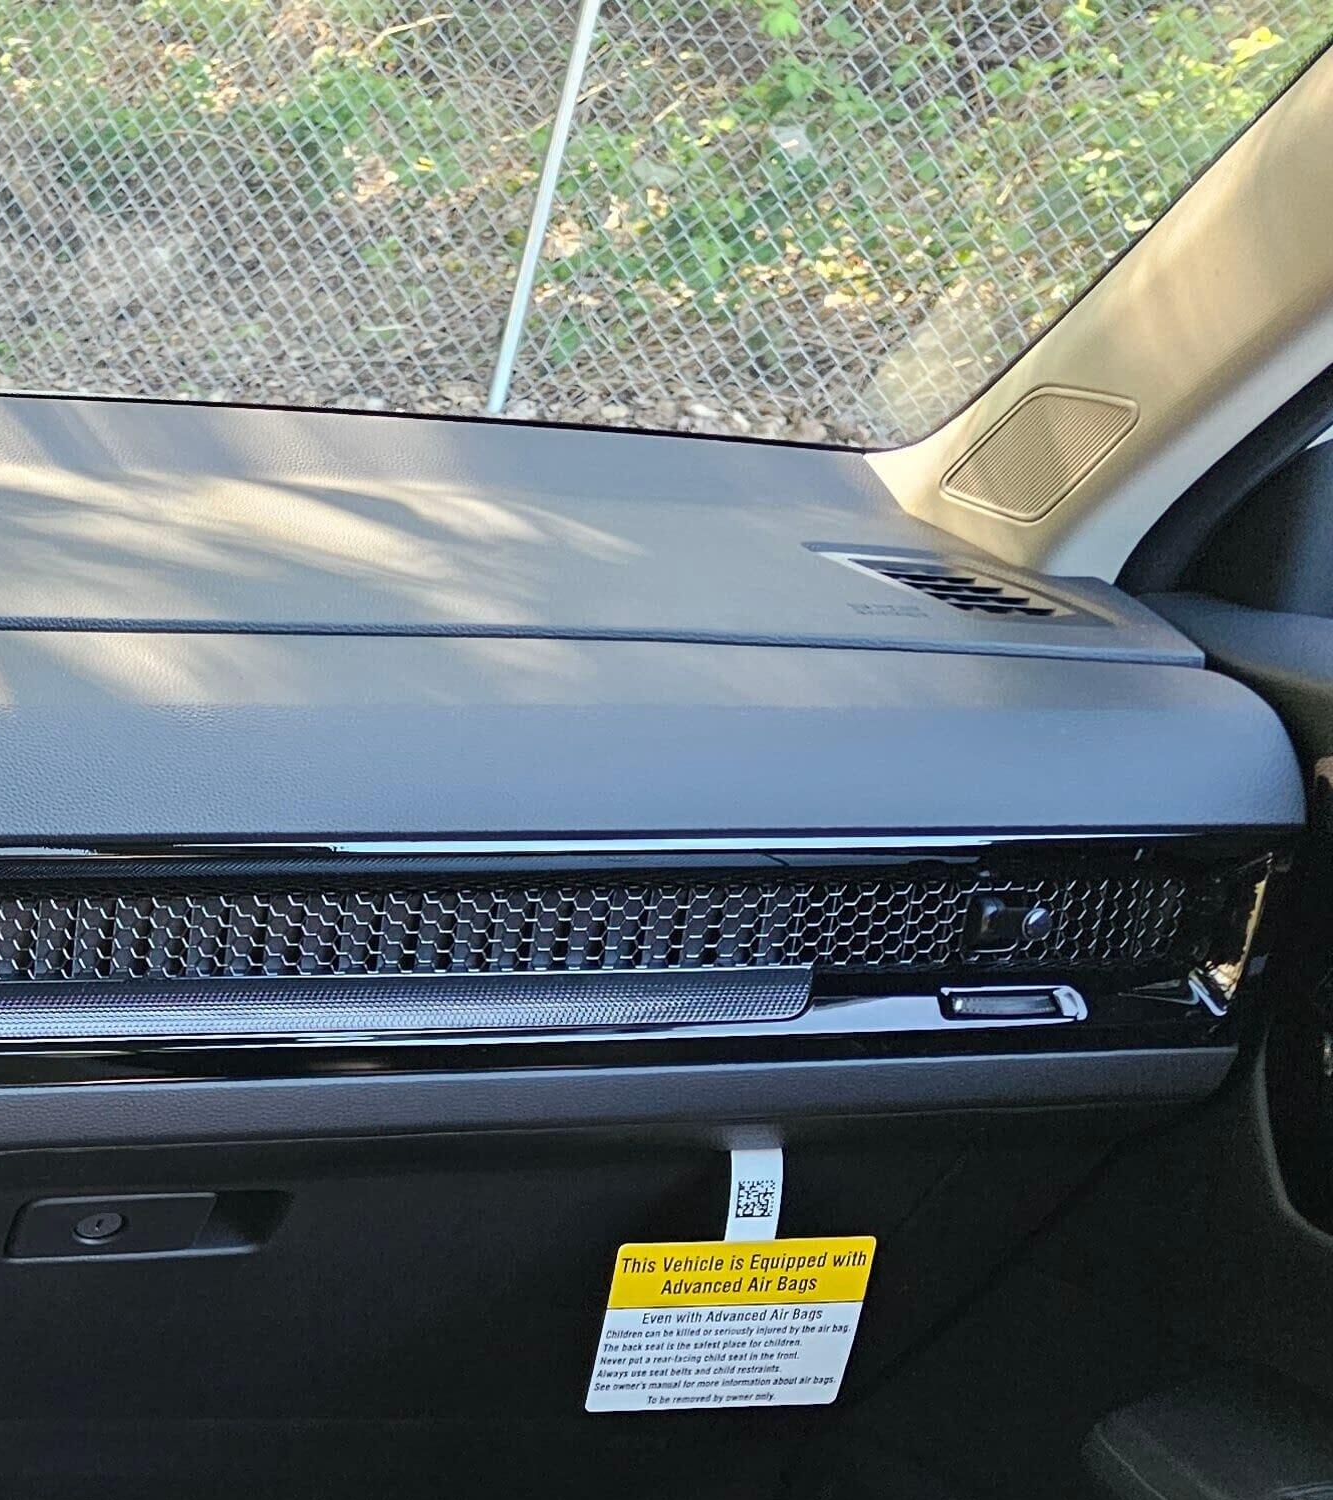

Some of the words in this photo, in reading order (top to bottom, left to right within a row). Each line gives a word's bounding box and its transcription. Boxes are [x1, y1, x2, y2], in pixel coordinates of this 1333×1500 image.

[622, 1258, 657, 1273] This
[664, 1255, 724, 1272] Vehicle
[730, 1255, 744, 1270] is
[750, 1252, 826, 1272] Equipped
[833, 1251, 867, 1267] with
[661, 1277, 743, 1295] Advanced
[747, 1277, 772, 1292] Air
[777, 1276, 817, 1293] Bags
[642, 1312, 672, 1324] Even
[676, 1312, 702, 1323] with
[706, 1310, 767, 1322] Advanced
[770, 1309, 789, 1321] Air
[793, 1308, 823, 1322] Bags
[606, 1330, 642, 1339] Children
[663, 1329, 673, 1337] be
[676, 1328, 700, 1336] killed
[714, 1327, 754, 1336] seriously
[756, 1326, 787, 1335] injured
[789, 1325, 800, 1335] by
[802, 1325, 815, 1333] the
[818, 1324, 830, 1333] air
[832, 1324, 851, 1334] bag.
[603, 1344, 619, 1352] The
[621, 1343, 642, 1352] back
[645, 1342, 664, 1351] seat
[666, 1342, 674, 1350] is
[677, 1341, 691, 1350] the
[694, 1340, 720, 1349] safest
[722, 1340, 746, 1350] place
[749, 1339, 762, 1348] for
[764, 1339, 802, 1348] children.
[600, 1356, 627, 1365] Never
[628, 1356, 643, 1366] put
[653, 1354, 701, 1364] rear-facing
[704, 1353, 726, 1362] child
[728, 1352, 747, 1360] seat
[749, 1352, 758, 1360] in
[760, 1351, 774, 1360] the
[777, 1351, 800, 1360] front.
[597, 1370, 628, 1379] Always
[649, 1369, 668, 1377] seat
[670, 1368, 692, 1376] belts
[714, 1366, 735, 1375] child
[737, 1365, 781, 1374] restraints.
[594, 1383, 611, 1391] See
[612, 1382, 646, 1390] owner's
[649, 1380, 681, 1389] manual
[683, 1380, 695, 1388] for
[697, 1380, 719, 1388] more
[722, 1378, 771, 1387] information
[773, 1377, 797, 1385] about
[799, 1376, 811, 1384] air
[813, 1376, 836, 1385] bags.
[647, 1396, 657, 1404] To
[660, 1395, 670, 1404] be
[673, 1394, 711, 1403] removed
[714, 1394, 723, 1404] by
[755, 1392, 776, 1402] only.
